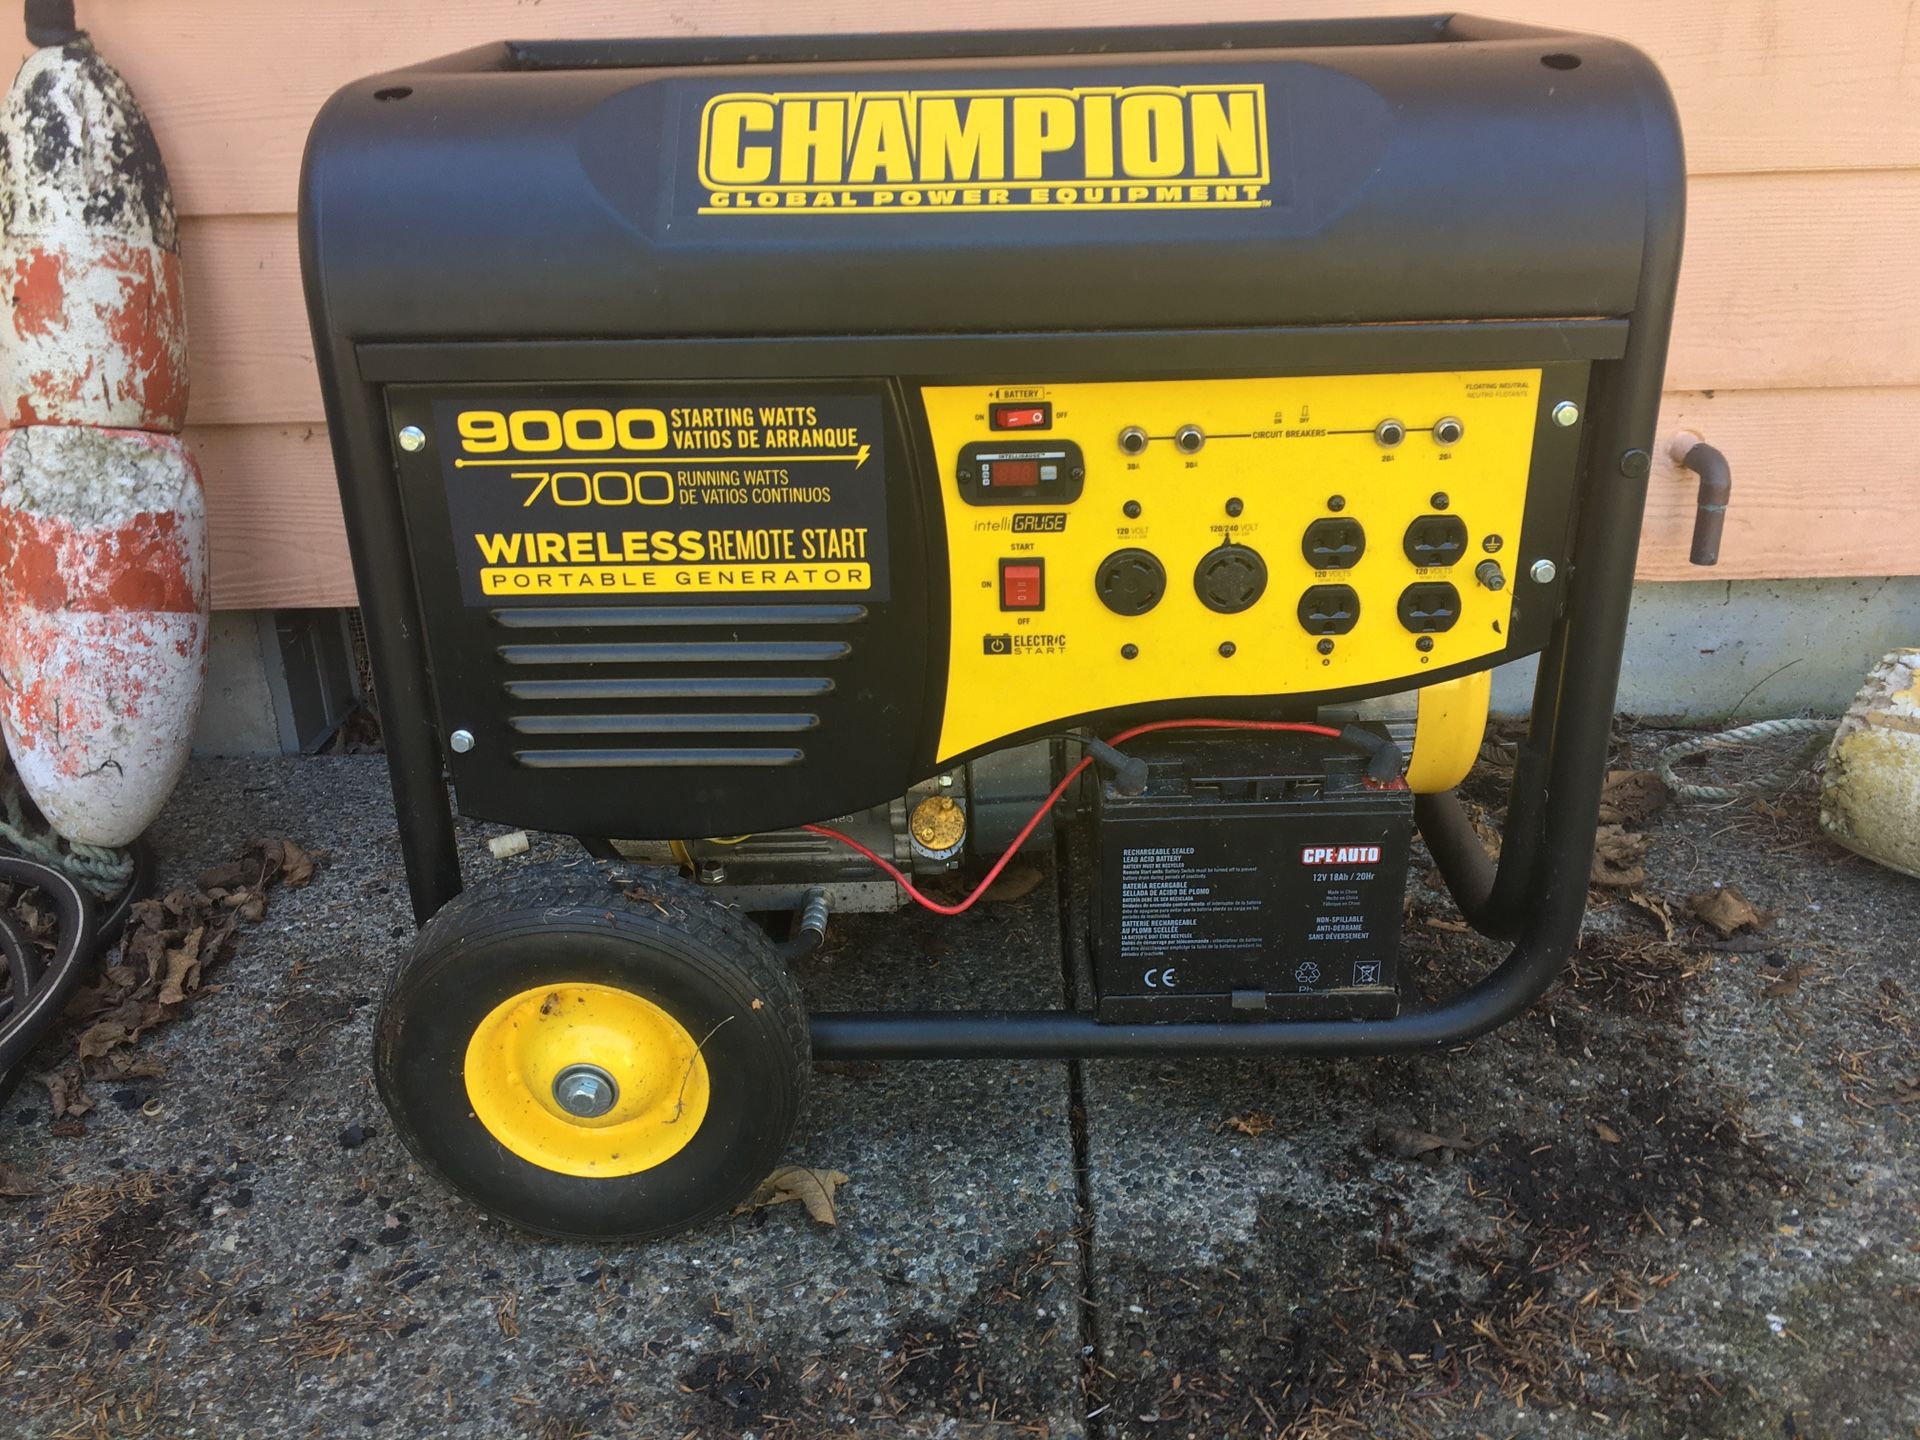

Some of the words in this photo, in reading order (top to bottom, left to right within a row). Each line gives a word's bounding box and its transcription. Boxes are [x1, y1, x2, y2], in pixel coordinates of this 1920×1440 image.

[709, 93, 1258, 184] CHAMPION
[710, 191, 858, 207] GLOBAL
[873, 189, 1010, 205] POWER
[1031, 185, 1261, 205] EQUIPMENT
[1004, 390, 1039, 398] BATTERY
[671, 408, 754, 428] STARTING
[759, 406, 817, 427] WATTS
[457, 409, 669, 453] 9000
[1252, 430, 1283, 439] CIRCUIT
[1285, 429, 1326, 438] BREAKERS
[673, 430, 732, 449] VATIOS
[738, 429, 760, 448] DE
[766, 428, 858, 448] ARRANQUE
[678, 470, 740, 487] RUNNING
[743, 469, 789, 486] WATTS
[511, 471, 674, 507] 7000
[680, 489, 698, 504] DE
[702, 488, 748, 504] VATIOS
[752, 487, 831, 503] CONTINUOS
[1116, 527, 1130, 535] 120
[1131, 526, 1149, 534] VOLT
[1241, 523, 1259, 531] VOLT
[475, 531, 706, 564] WIRELESS
[708, 530, 796, 560] REMOTE
[801, 528, 868, 559] START
[1011, 543, 1034, 551] START
[1429, 567, 1453, 575] VOLTS
[493, 571, 656, 588] PORTABLE
[676, 569, 863, 586] GENERATOR
[981, 581, 992, 589] ON
[1017, 617, 1031, 625] OFF
[1014, 647, 1066, 655] START
[1123, 848, 1171, 856] RECHARGEABLE
[1171, 847, 1195, 855] SEALED
[1313, 873, 1328, 882] 12V
[1330, 872, 1349, 881] 18Ah
[1356, 872, 1376, 881] 20Hr
[1122, 881, 1148, 890] BATERÍA
[1149, 881, 1188, 889] RECARGABLE
[1123, 889, 1148, 897] SELLADA
[1316, 915, 1364, 923] NON-SPILLABLE
[1122, 920, 1150, 928] BATTERIE
[1316, 924, 1362, 932] ANTI-DERRAME
[1308, 933, 1324, 941] SANS
